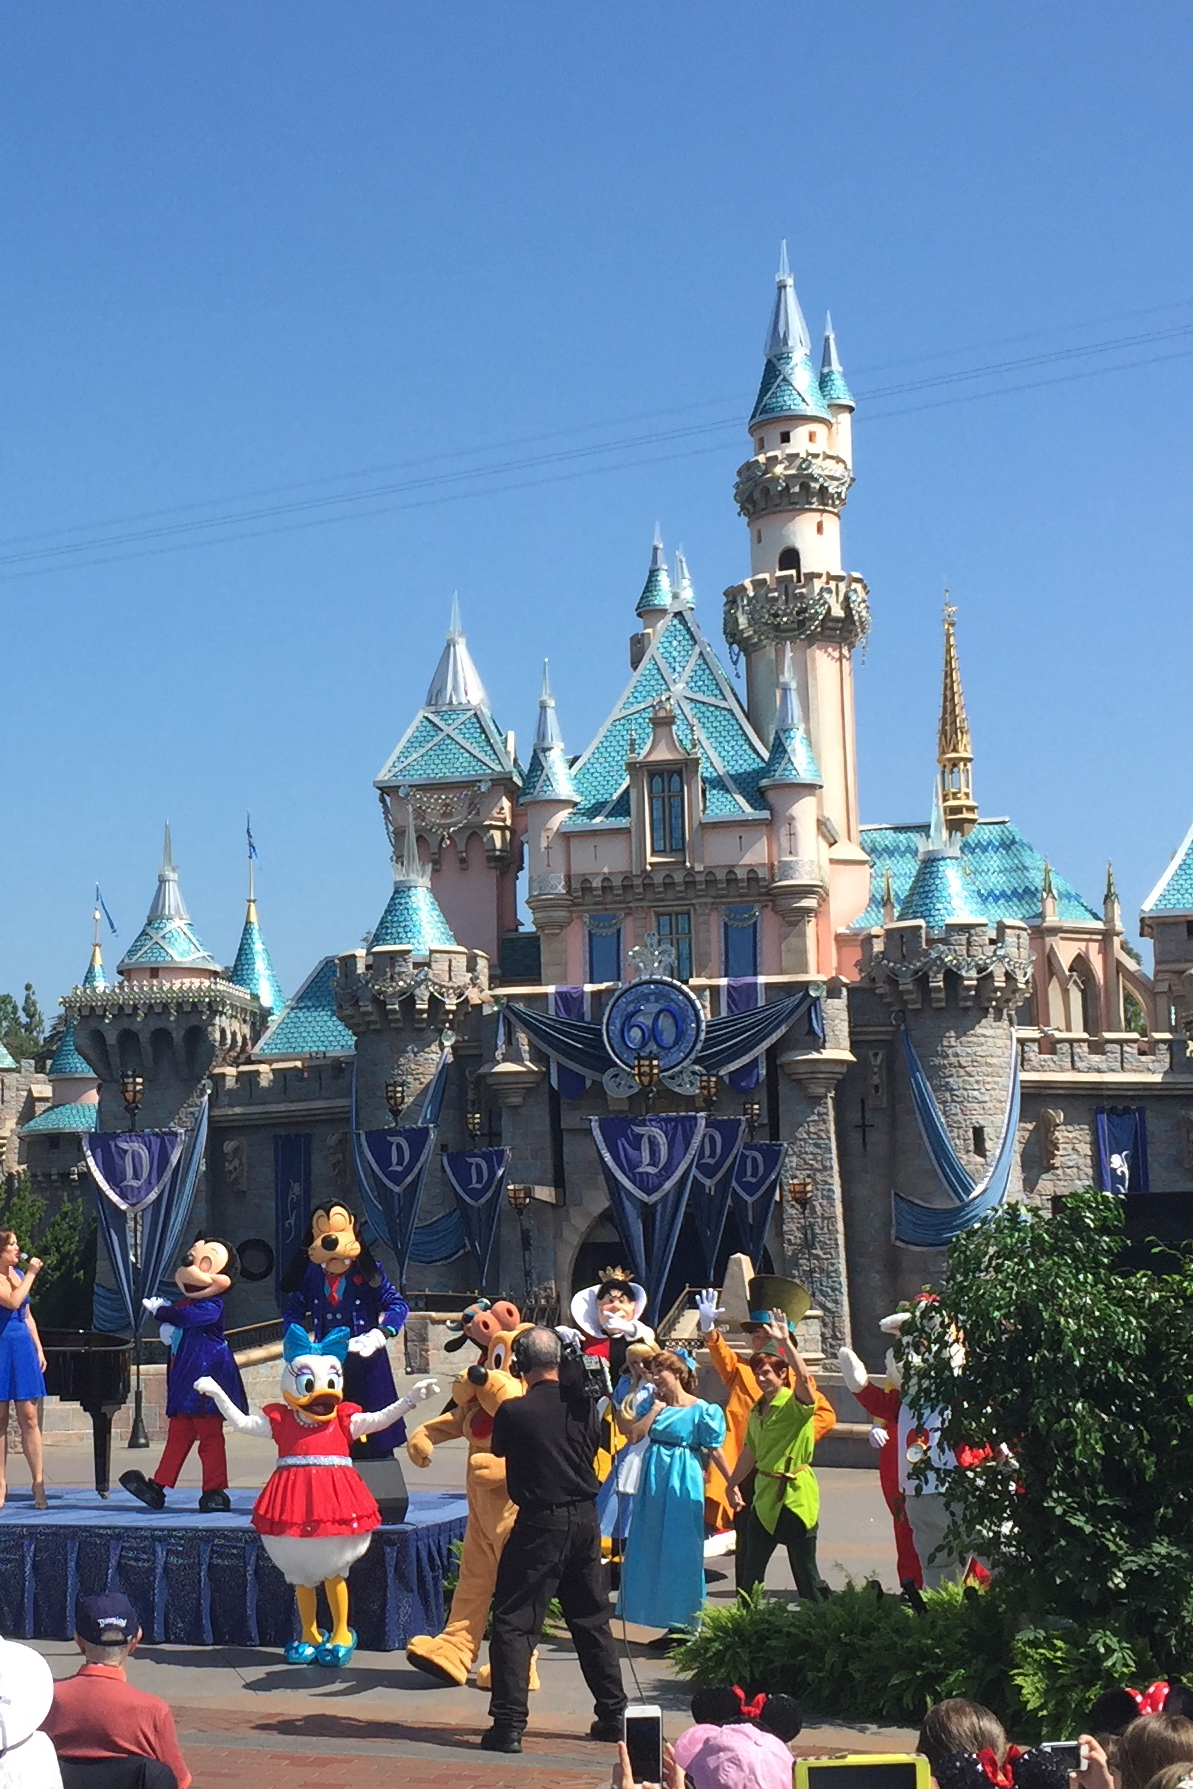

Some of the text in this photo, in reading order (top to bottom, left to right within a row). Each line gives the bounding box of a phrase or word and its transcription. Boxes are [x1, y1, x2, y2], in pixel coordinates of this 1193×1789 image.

[622, 1005, 684, 1050] 60
[115, 1140, 150, 1188] D
[387, 1136, 410, 1172] D
[630, 1124, 668, 1175] D
[700, 1128, 722, 1165] D
[465, 1157, 489, 1189] D
[740, 1150, 765, 1183] D
